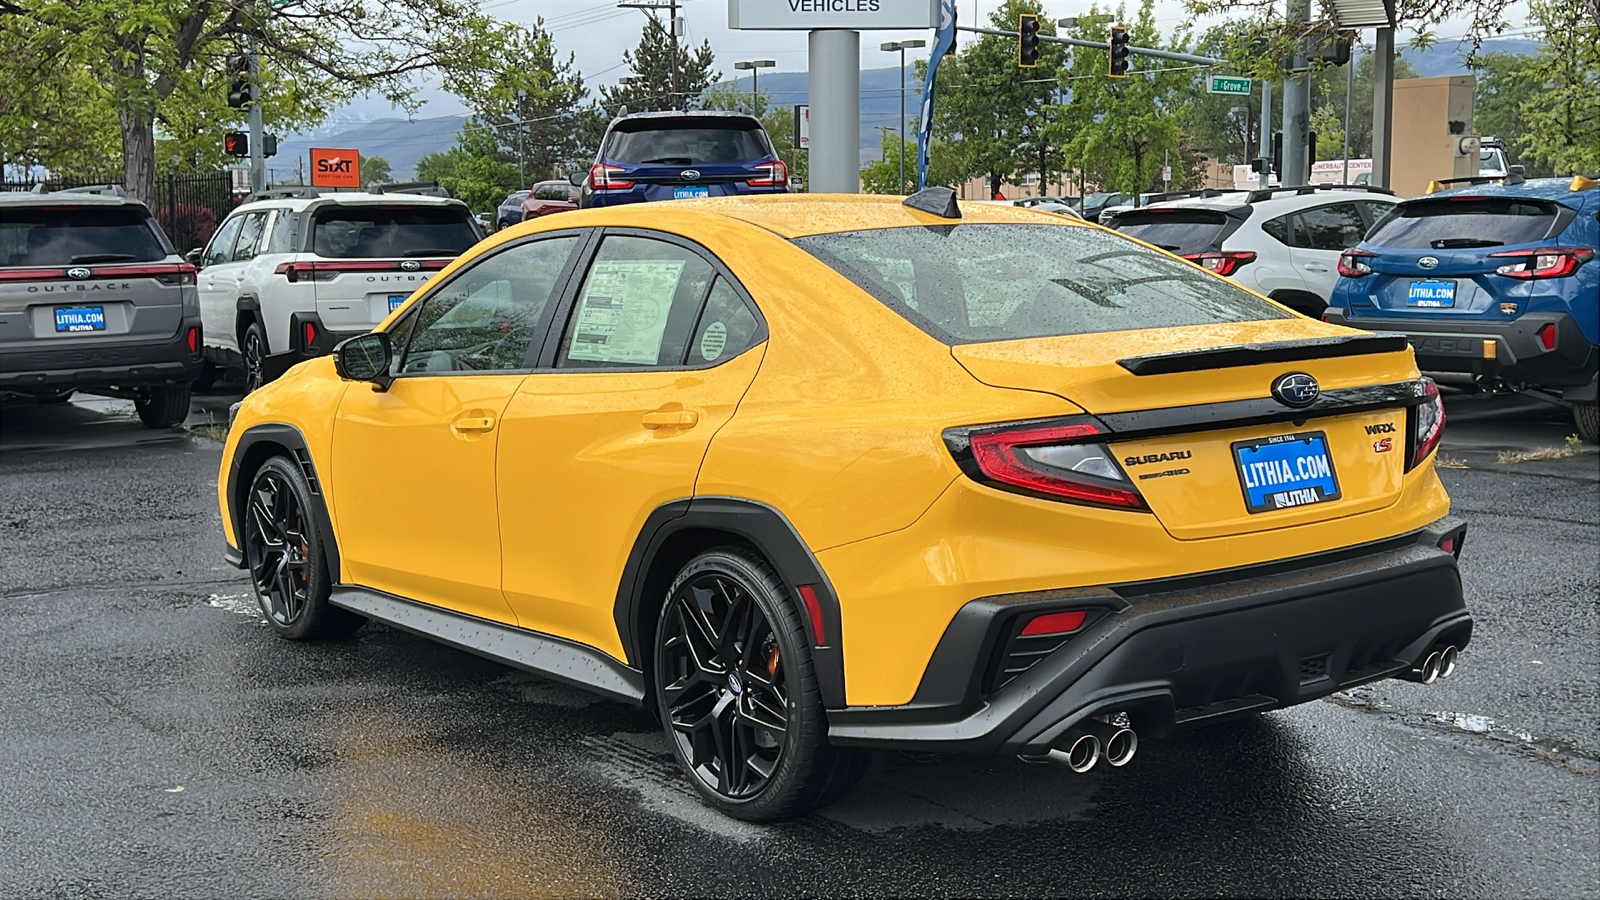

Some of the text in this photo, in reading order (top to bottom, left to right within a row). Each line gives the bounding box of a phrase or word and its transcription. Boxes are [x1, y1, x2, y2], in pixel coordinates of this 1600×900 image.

[788, 0, 880, 12] VEHICLES
[1223, 80, 1242, 91] Grove
[1348, 161, 1372, 169] CENTER
[673, 190, 709, 199] LITHIA.COM
[27, 283, 131, 293] OUTBACK
[1408, 287, 1454, 299] LITHIA.COM
[56, 312, 104, 325] LITHIA.COM
[1364, 422, 1396, 435] WRX
[1268, 436, 1284, 444] SINCE
[1124, 450, 1193, 467] SUBARU
[1242, 454, 1331, 489] LITHIA.COM
[1283, 487, 1320, 507] LITHIA
